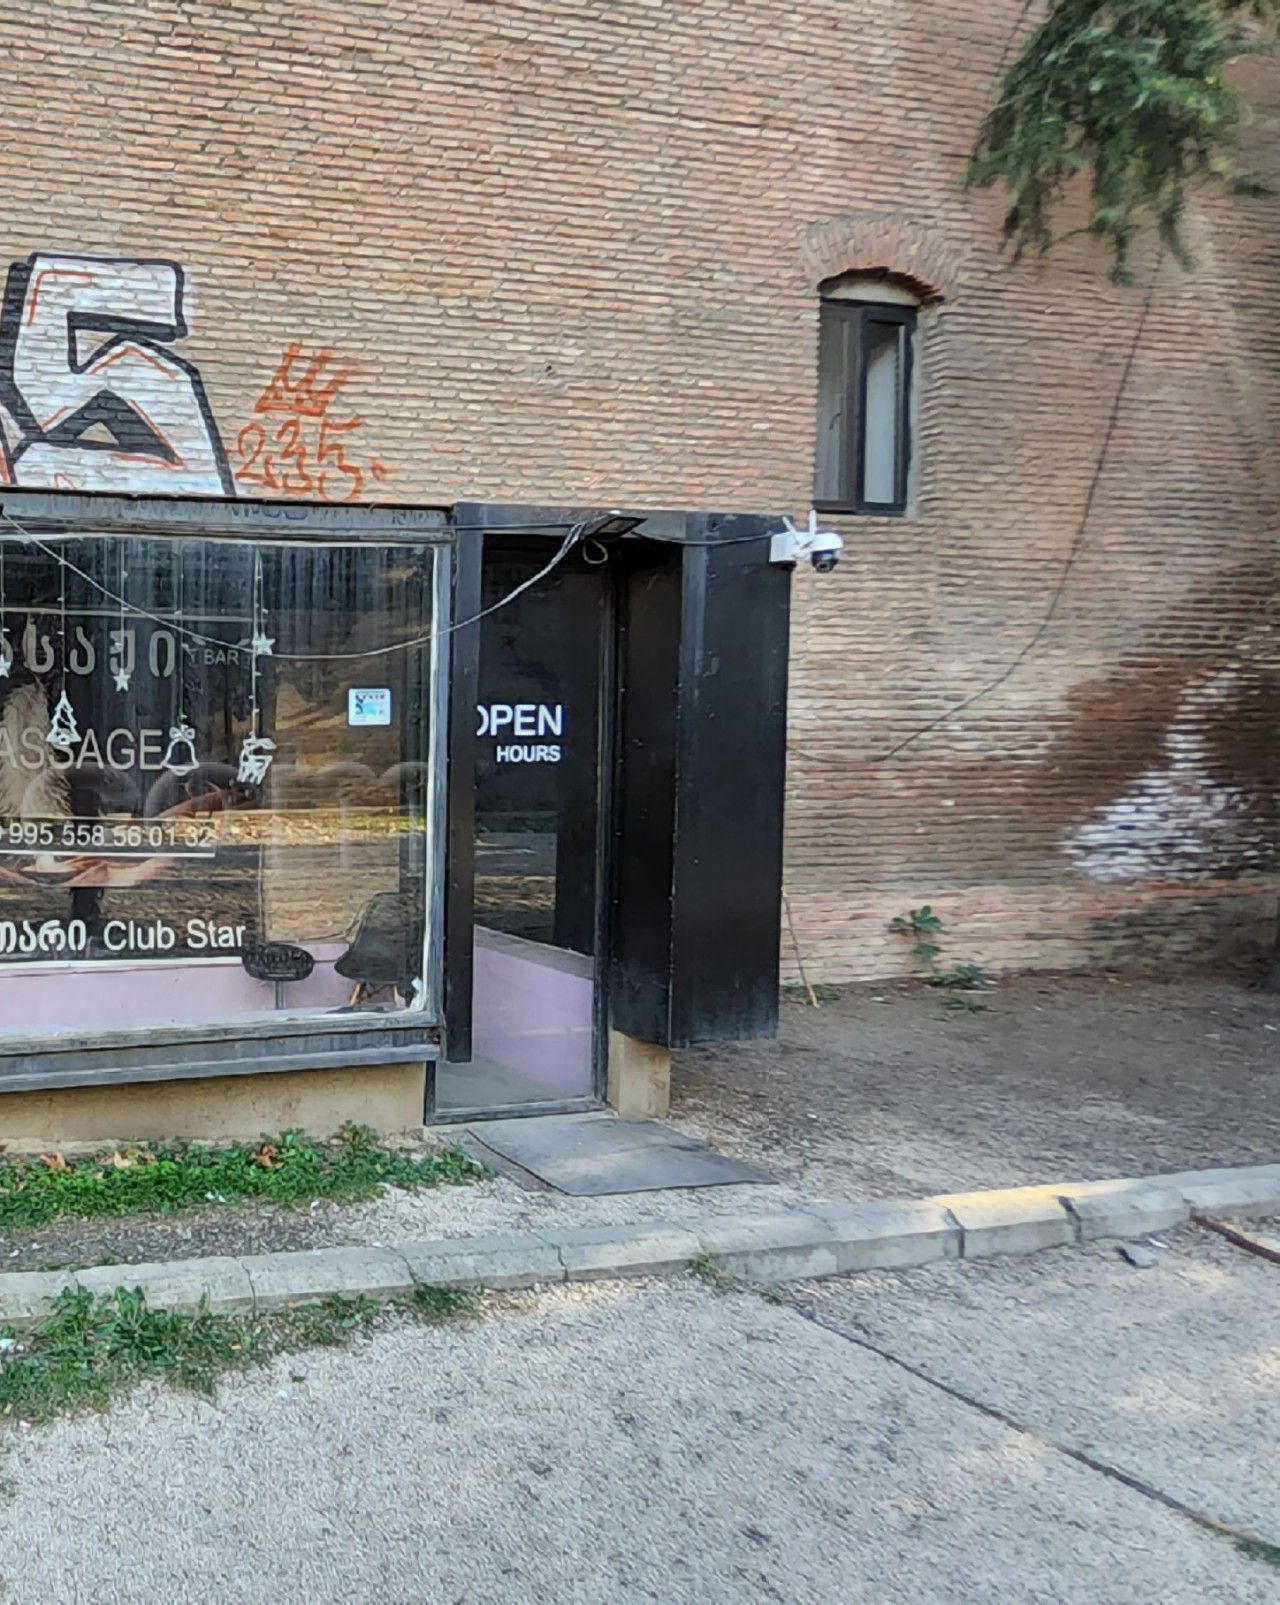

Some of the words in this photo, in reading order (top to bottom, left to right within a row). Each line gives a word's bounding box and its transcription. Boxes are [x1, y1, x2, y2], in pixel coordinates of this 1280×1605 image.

[203, 648, 240, 666] BAR
[496, 745, 562, 763] HOURS
[61, 823, 105, 847] 558
[113, 825, 142, 847] 56
[149, 826, 176, 848] 01
[185, 826, 213, 848] 32
[103, 919, 175, 951] Club
[182, 917, 246, 948] Star
